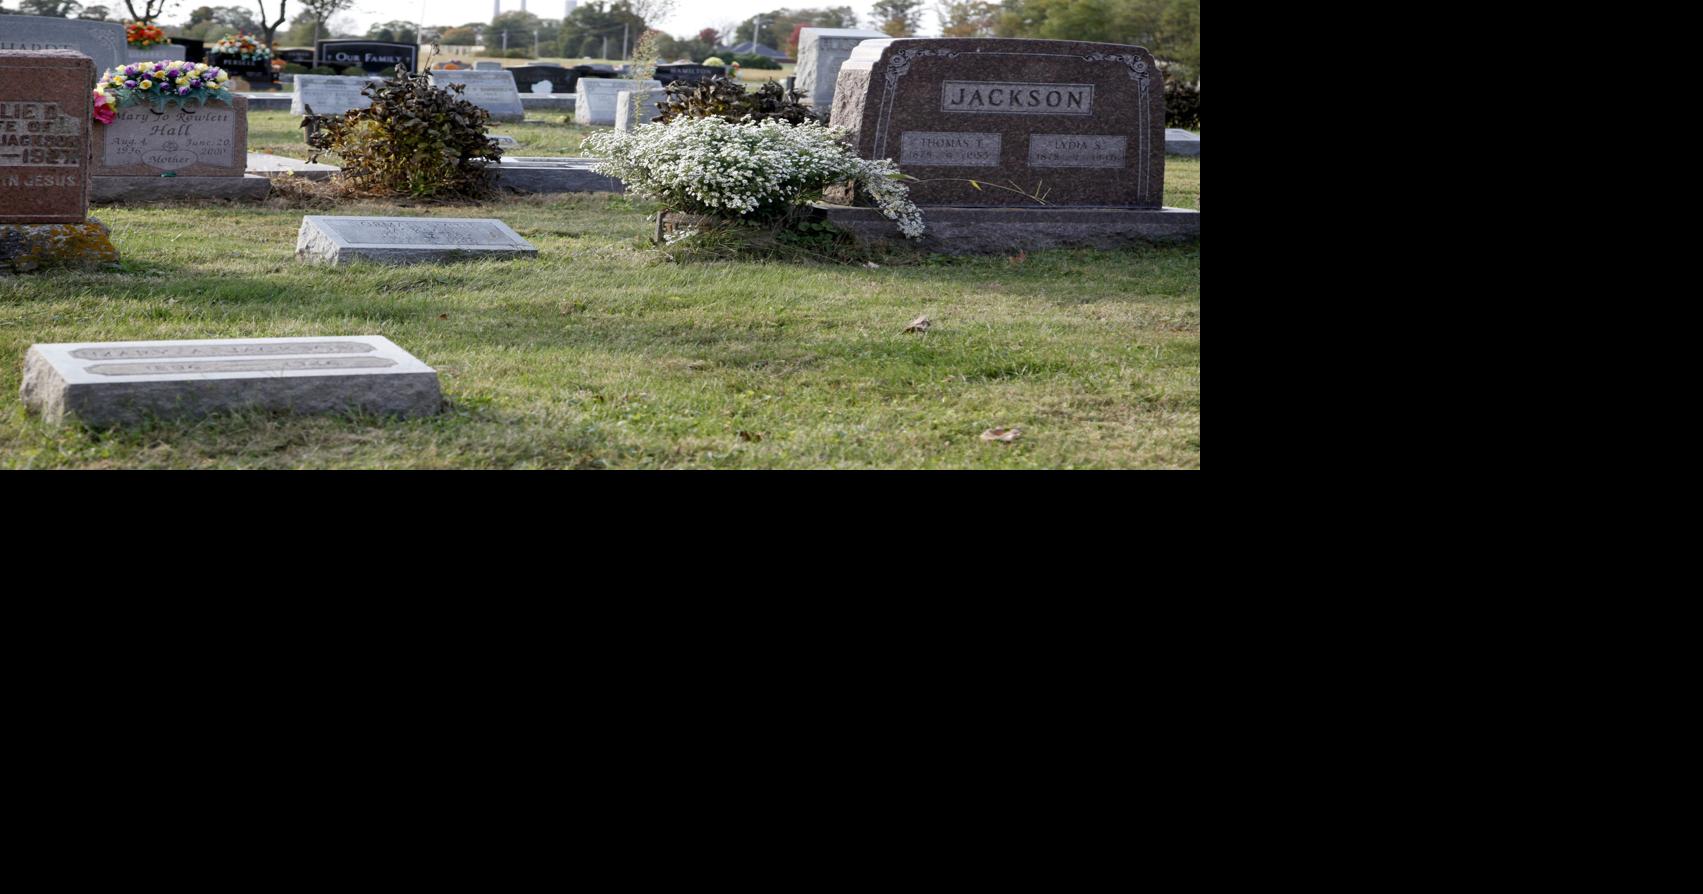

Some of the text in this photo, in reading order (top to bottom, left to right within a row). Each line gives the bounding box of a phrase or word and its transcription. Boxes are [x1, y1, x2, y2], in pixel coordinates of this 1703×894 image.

[951, 88, 1083, 109] JACKSON
[116, 111, 149, 124] Mary
[175, 110, 228, 123] Rowlett
[149, 124, 193, 136] Hall
[920, 137, 970, 148] THOMAS
[1055, 140, 1088, 151] LYDIA
[149, 154, 191, 163] Mother
